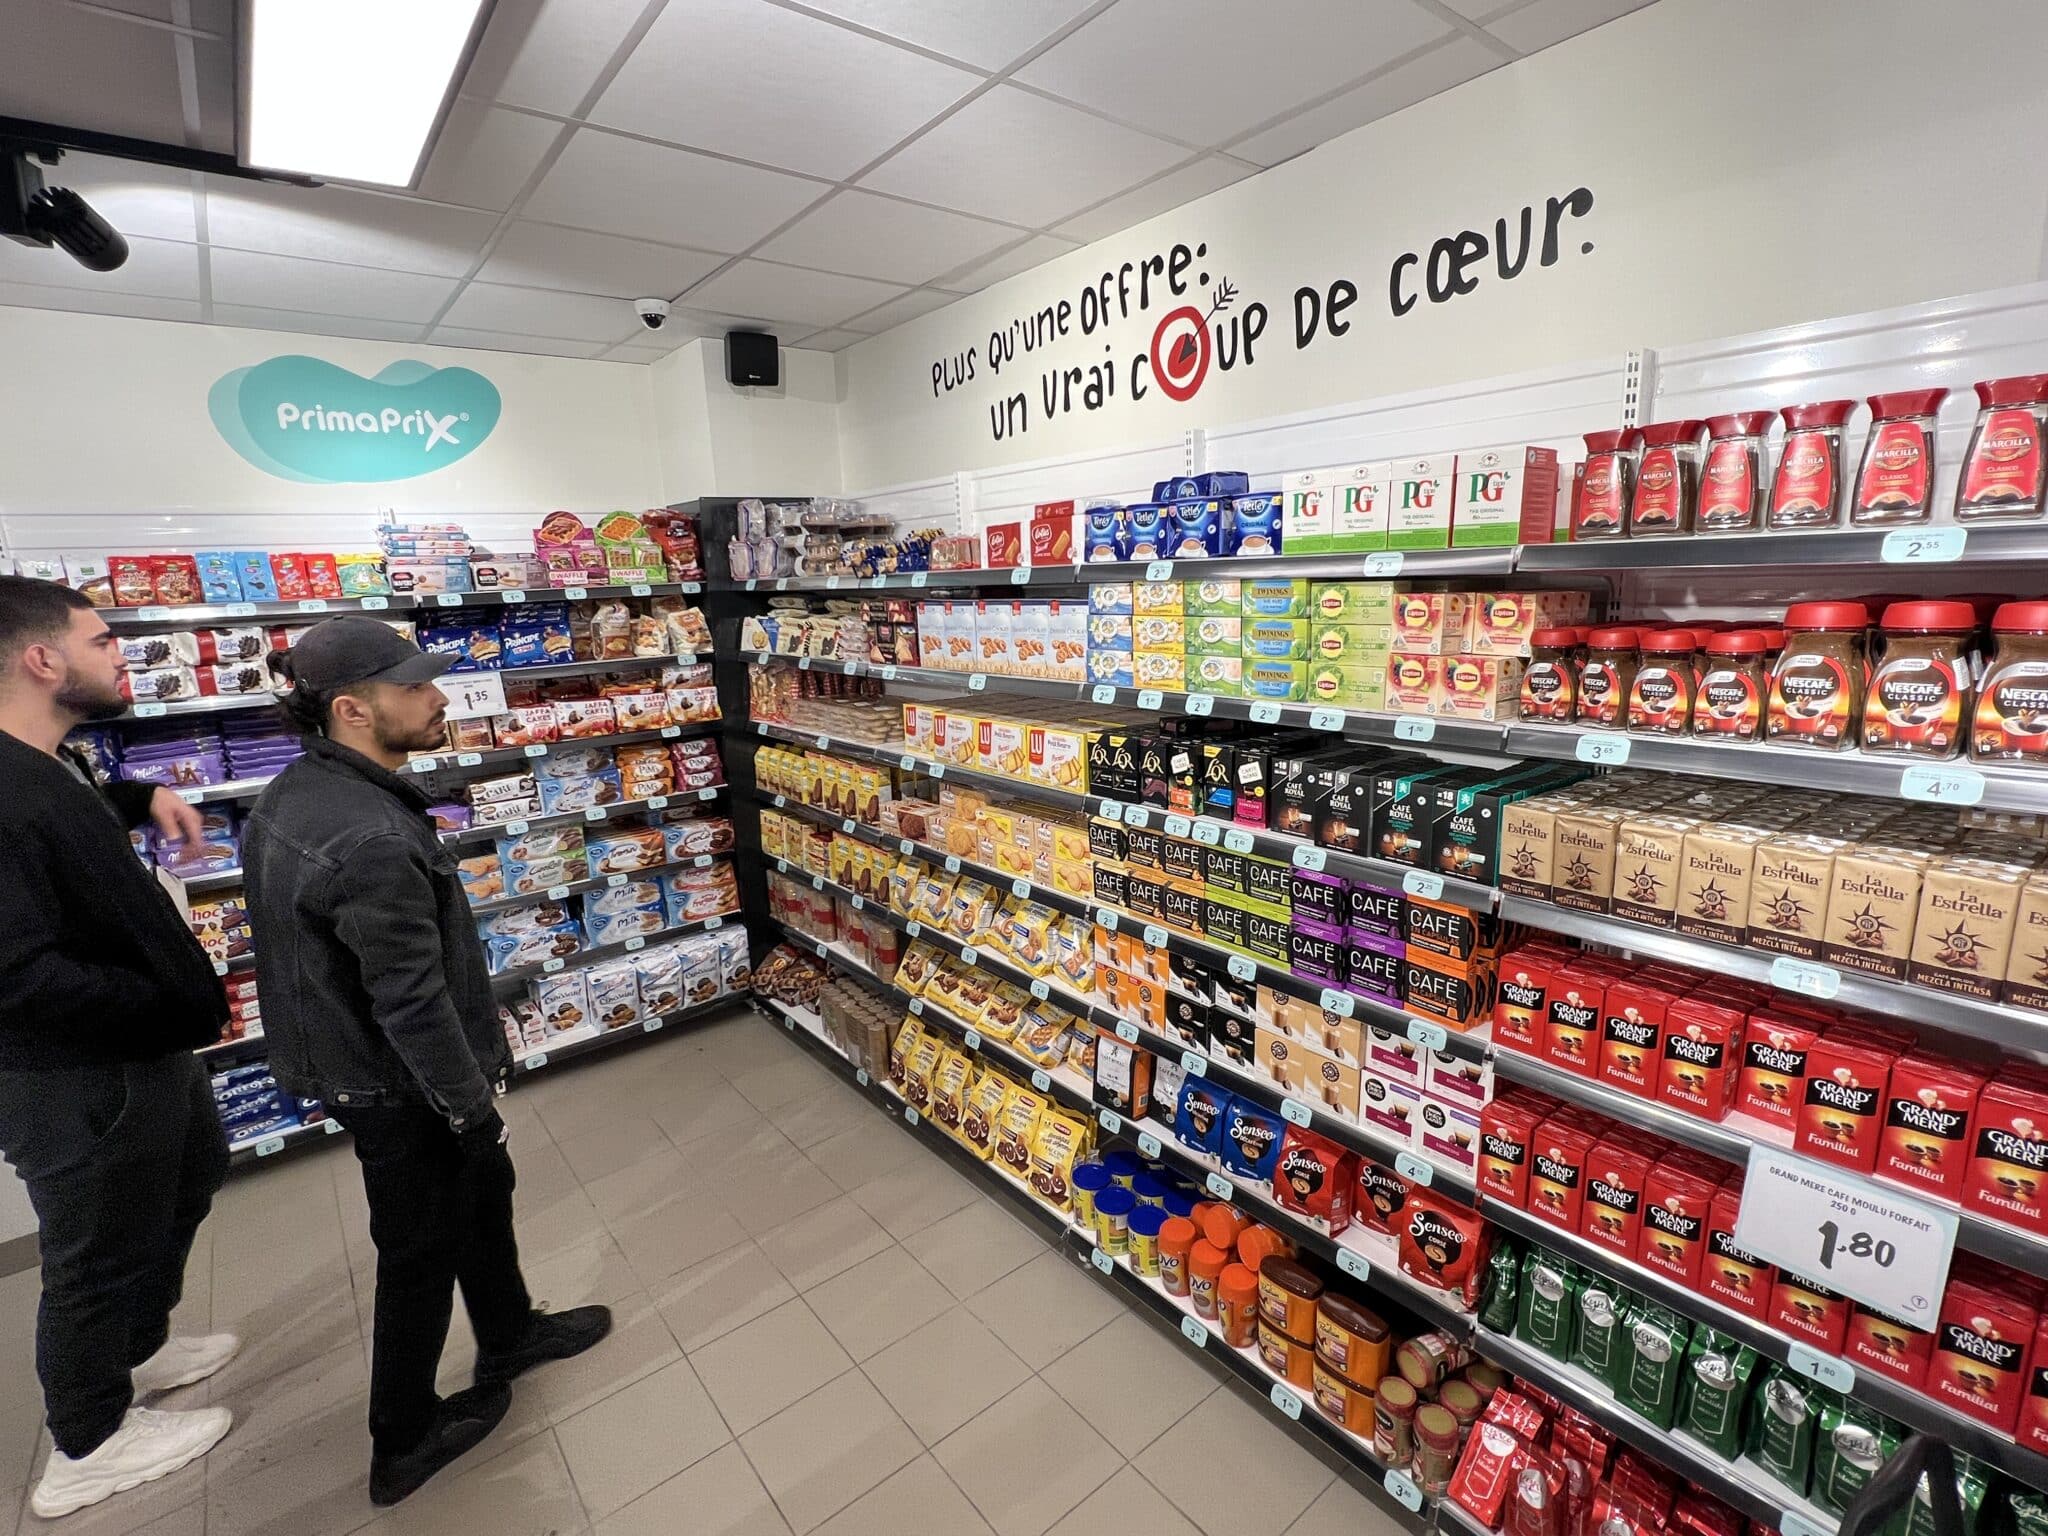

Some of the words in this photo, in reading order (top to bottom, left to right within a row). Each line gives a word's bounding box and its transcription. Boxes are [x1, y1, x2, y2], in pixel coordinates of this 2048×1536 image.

[931, 346, 977, 398] PLUS
[1983, 437, 2032, 450] MARCILLA
[1785, 455, 1825, 467] MARCILLA
[1875, 447, 1920, 460] MARCILLA
[1642, 471, 1673, 481] MARCILLA
[1401, 479, 1435, 509] PG
[1468, 471, 1504, 503] PG
[1241, 498, 1267, 513] Tetley
[1291, 490, 1319, 519] PG
[1343, 485, 1374, 514] PG
[1135, 511, 1156, 525] Tetley
[1179, 505, 1202, 520] Tetley
[1906, 541, 1940, 558] 2.55
[1256, 586, 1290, 596] TWININGS
[1321, 598, 1342, 608] Lipton
[1406, 608, 1426, 618] Lipton
[1493, 608, 1516, 618] Lipton
[503, 632, 540, 651] PRINCIPE
[1257, 629, 1290, 638] TWININGS
[1321, 639, 1341, 649] Lipton
[1256, 670, 1289, 680] TWININGS
[1401, 669, 1422, 679] Lipton
[1456, 673, 1478, 683] Lipton
[1317, 680, 1337, 690] Lipton
[1641, 682, 1675, 694] NESCAFÉ
[1783, 676, 1835, 691] NESCAFÉ
[1884, 681, 1944, 696] NESCAFÉ
[1708, 686, 1745, 698] NESCAFÉ
[1710, 694, 1740, 702] CLASSIC
[1786, 687, 1829, 697] CLASSIC
[1887, 692, 1937, 703] CLASSIC
[464, 690, 489, 711] 1.35
[584, 701, 608, 710] JAFFA
[584, 707, 609, 716] CAKES
[906, 707, 916, 727] LU
[934, 716, 946, 737] LU
[979, 723, 992, 745] LU
[1030, 731, 1044, 755] LU
[1592, 746, 1615, 760] 3.65
[132, 765, 163, 780] Milka
[1284, 787, 1305, 797] ROYAL
[1286, 780, 1303, 790] CAFÉ
[1926, 781, 1960, 799] 4.70
[1329, 799, 1353, 811] ROYAL
[1332, 792, 1350, 803] CAFÉ
[1389, 809, 1414, 821] ROYAL
[1391, 802, 1411, 814] CAFÉ
[1449, 822, 1477, 835] ROYAL
[1452, 814, 1474, 827] CAFÉ
[1521, 819, 1533, 829] La
[1507, 822, 1548, 841] Estrella
[1576, 829, 1589, 840] La
[1560, 832, 1604, 851] Estrella
[1642, 839, 1656, 850] La
[1708, 851, 1724, 864] La
[1689, 856, 1743, 877] Estrella
[1783, 860, 1799, 873] La
[1761, 865, 1820, 888] Estrella
[1864, 874, 1882, 888] La
[613, 885, 638, 900] Milk
[1502, 883, 1521, 895] MEZCLA
[1521, 887, 1545, 899] INTENSA
[1840, 878, 1905, 902] Estrella
[1959, 889, 1979, 905] La
[1930, 893, 2003, 921] Estrella
[617, 915, 641, 930] Milk
[1616, 906, 1639, 920] MEZCLA
[1639, 912, 1667, 926] INTENSA
[1682, 924, 1708, 938] MEZCLA
[1708, 930, 1738, 944] INTENSA
[1752, 935, 1780, 951] MEZCLA
[1780, 940, 1813, 957] INTENSA
[1829, 951, 1861, 968] MEZCLA
[1861, 958, 1897, 976] INTENSA
[1916, 972, 1951, 990] MEZCLA
[1952, 979, 1992, 998] INTENSA
[1500, 1026, 1533, 1045] Familial
[1551, 1046, 1587, 1066] Familial
[1606, 1065, 1645, 1086] Familial
[1666, 1084, 1708, 1107] Familial
[1184, 1092, 1221, 1116] Senseo
[1746, 1093, 1793, 1117] Familial
[234, 1118, 275, 1140] OREO
[1230, 1117, 1277, 1141] Senseo
[1807, 1133, 1860, 1158] Familial
[1281, 1150, 1327, 1174] Senseo
[1889, 1156, 1945, 1184] Familial
[1359, 1165, 1410, 1194] Senseo
[1483, 1175, 1515, 1198] Familial
[1768, 1165, 1799, 1185] GRAND
[1799, 1177, 1825, 1195] MERE
[1826, 1188, 1850, 1203] CAFE
[1851, 1197, 1887, 1217] MOULU
[1888, 1209, 1932, 1233] FORFAIT
[1830, 1199, 1848, 1213] 250
[1977, 1188, 2042, 1220] Familial
[1534, 1198, 1568, 1221] Familial
[1408, 1211, 1468, 1244] Senseo
[1589, 1223, 1627, 1248] Familial
[1646, 1251, 1688, 1277] Familial
[1711, 1279, 1756, 1307] Familial
[1780, 1310, 1829, 1341] Familial
[1856, 1342, 1911, 1374] Familial
[1940, 1379, 2001, 1414] Familial
